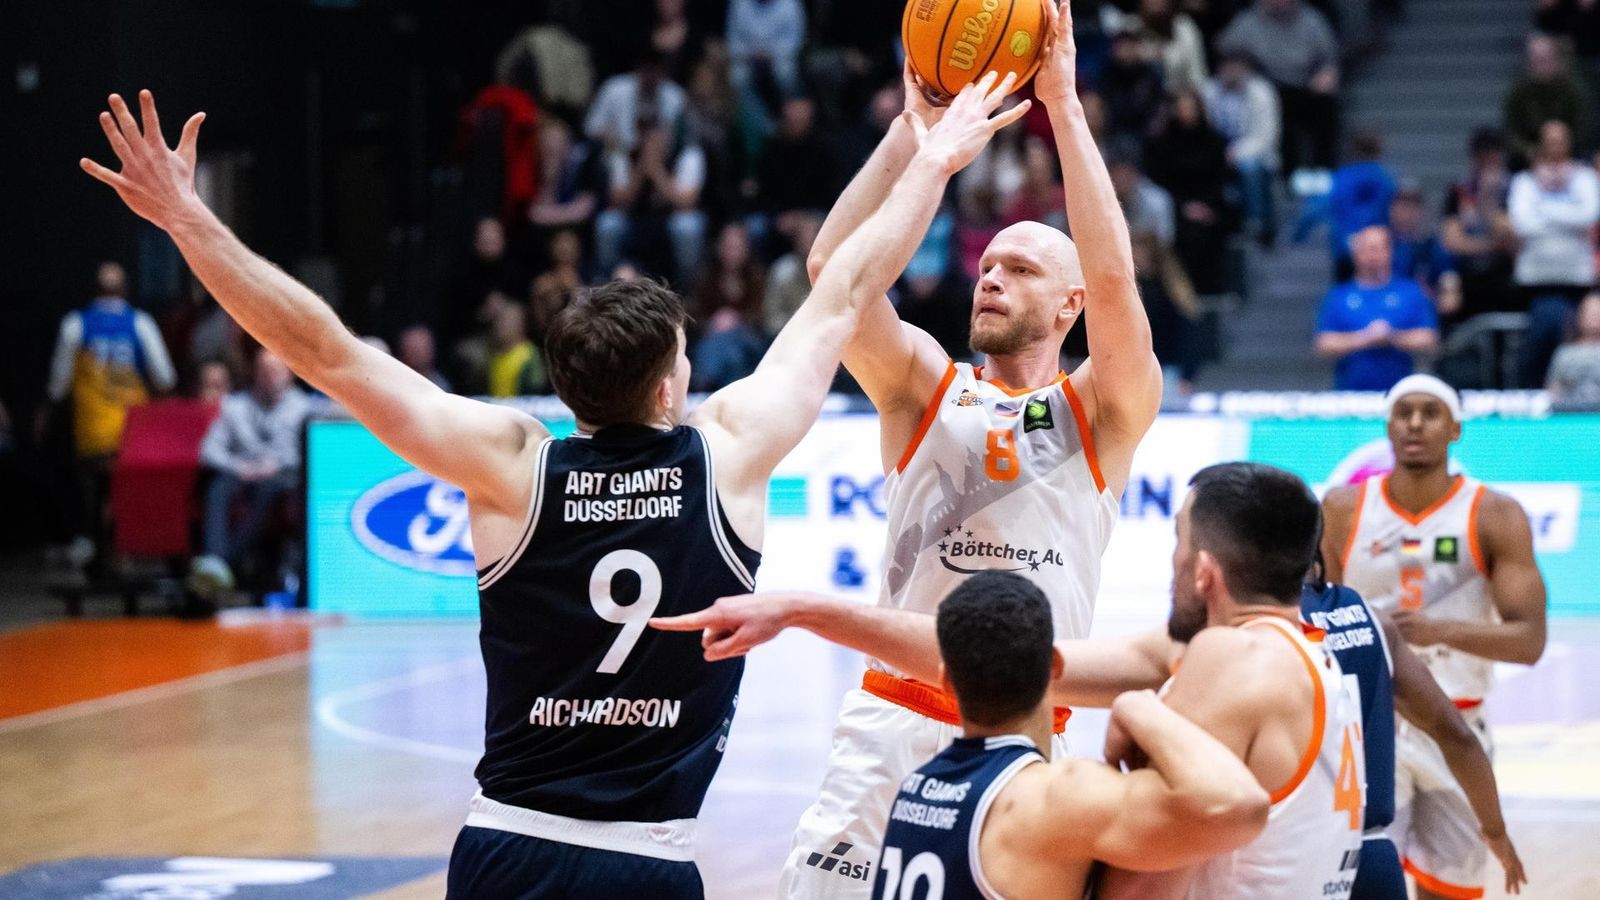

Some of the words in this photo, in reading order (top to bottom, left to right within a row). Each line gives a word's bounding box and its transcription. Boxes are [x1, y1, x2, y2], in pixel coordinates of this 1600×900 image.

[984, 429, 1020, 482] 8
[565, 471, 606, 495] ART
[609, 467, 682, 495] GIANTS
[564, 496, 682, 522] DÜSSELDORF
[950, 540, 1037, 562] Böttcher
[1400, 568, 1425, 610] 5
[589, 549, 662, 674] 9
[529, 697, 681, 728] RICHARDSON
[838, 860, 871, 881] asi
